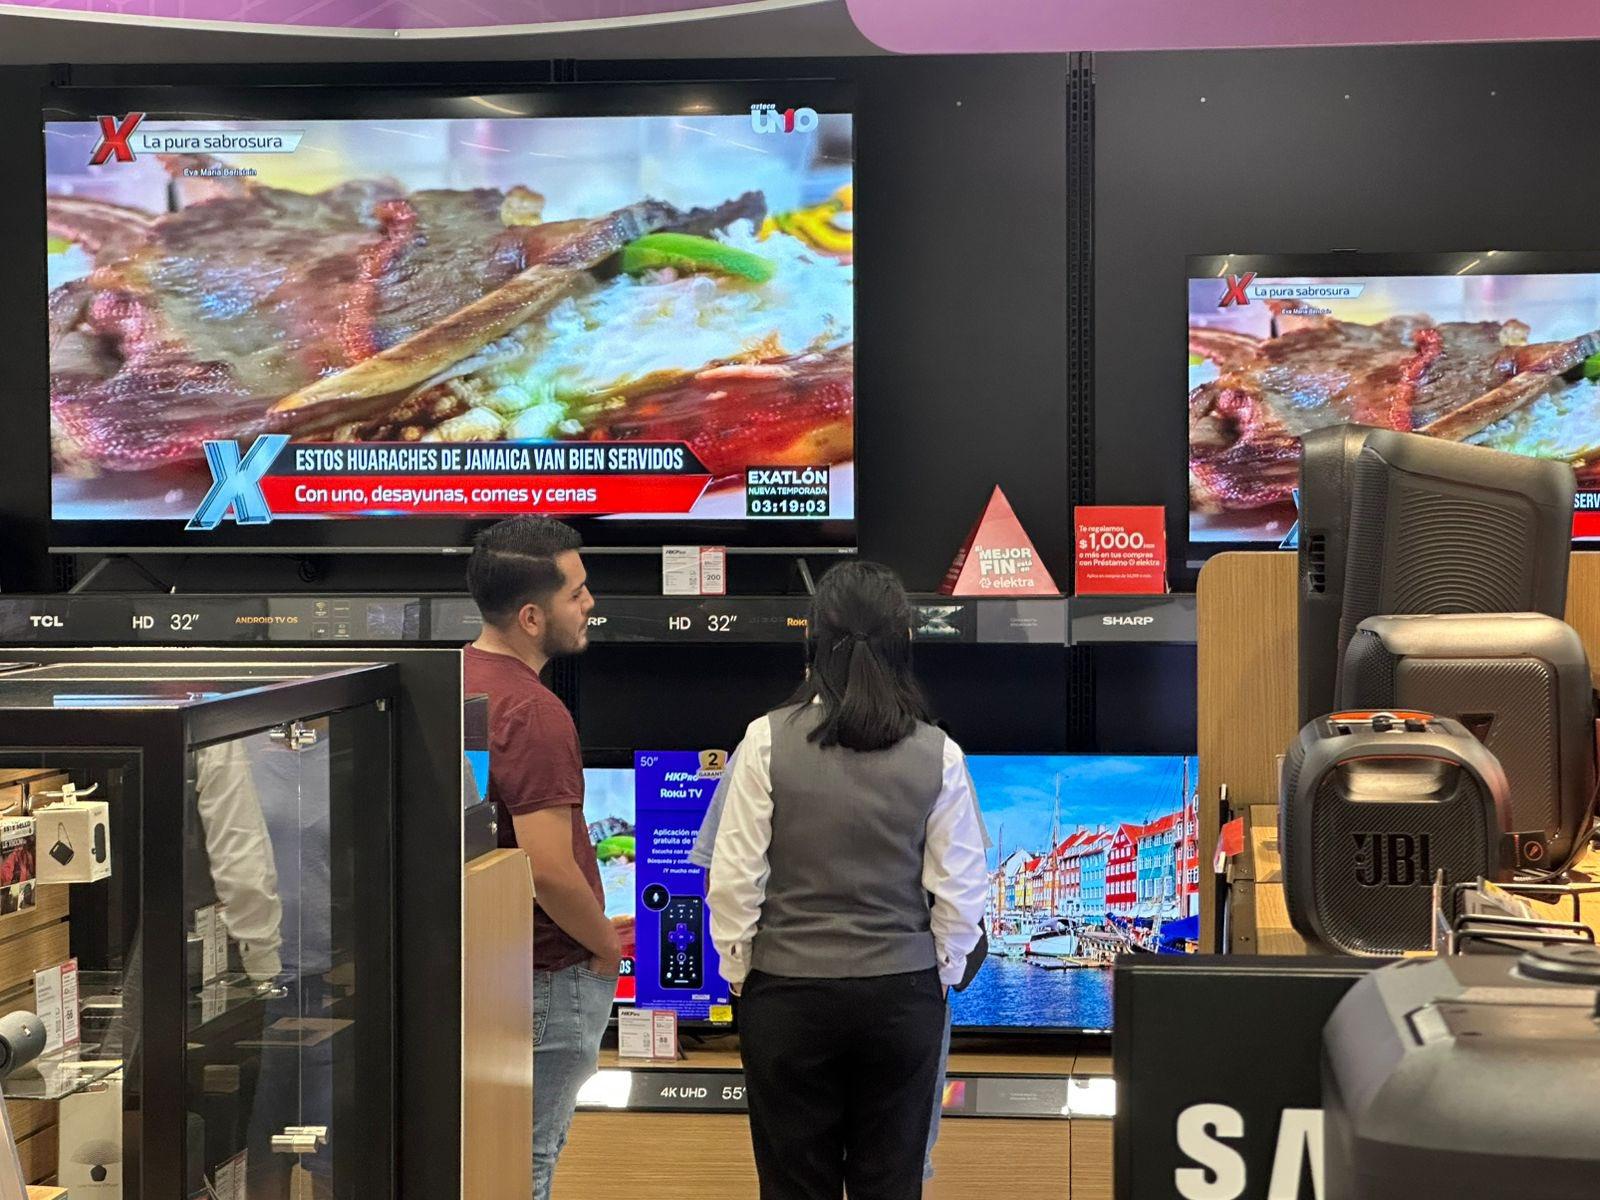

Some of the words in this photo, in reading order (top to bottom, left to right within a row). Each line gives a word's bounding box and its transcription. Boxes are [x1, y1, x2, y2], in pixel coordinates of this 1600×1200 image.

[143, 134, 160, 148] La
[164, 136, 200, 150] pura
[204, 134, 282, 148] sabrosura
[1254, 286, 1267, 297] La
[1269, 287, 1294, 298] pura
[1296, 286, 1350, 297] sabrosura
[295, 449, 344, 471] ESTOS
[347, 448, 436, 471] HUARACHES
[441, 448, 462, 470] DE
[465, 448, 531, 470] JAMAICA
[534, 448, 565, 470] VAN
[569, 448, 605, 470] BIEN
[608, 447, 684, 470] SERVIDOS
[748, 467, 828, 484] EXATLÓN
[295, 485, 328, 503] Con
[331, 489, 368, 505] uno,
[371, 485, 468, 506] desayunas,
[471, 488, 528, 502] comes
[532, 488, 543, 505] y
[545, 488, 597, 502] cenas
[748, 487, 777, 495] NUEVA
[777, 487, 828, 495] TEMPORADA
[751, 500, 826, 513] 03:19:03
[1088, 525, 1124, 533] regalamos
[979, 548, 1032, 559] MEJOR
[1122, 552, 1154, 560] compras
[980, 559, 1016, 575] FIN
[993, 577, 1035, 588] elektra
[30, 615, 64, 627] TCL
[132, 616, 154, 629] HD
[235, 616, 273, 624] ANDROID
[274, 616, 286, 624] TV
[286, 616, 298, 624] OS
[669, 616, 691, 630] HD
[1102, 616, 1154, 626] SHARP
[708, 752, 718, 766] 2
[688, 788, 703, 798] TV
[653, 829, 690, 837] Aplicación
[653, 837, 681, 845] gratuita
[1352, 833, 1447, 887] JBL
[660, 1087, 678, 1098] 4K
[680, 1087, 707, 1098] UHD
